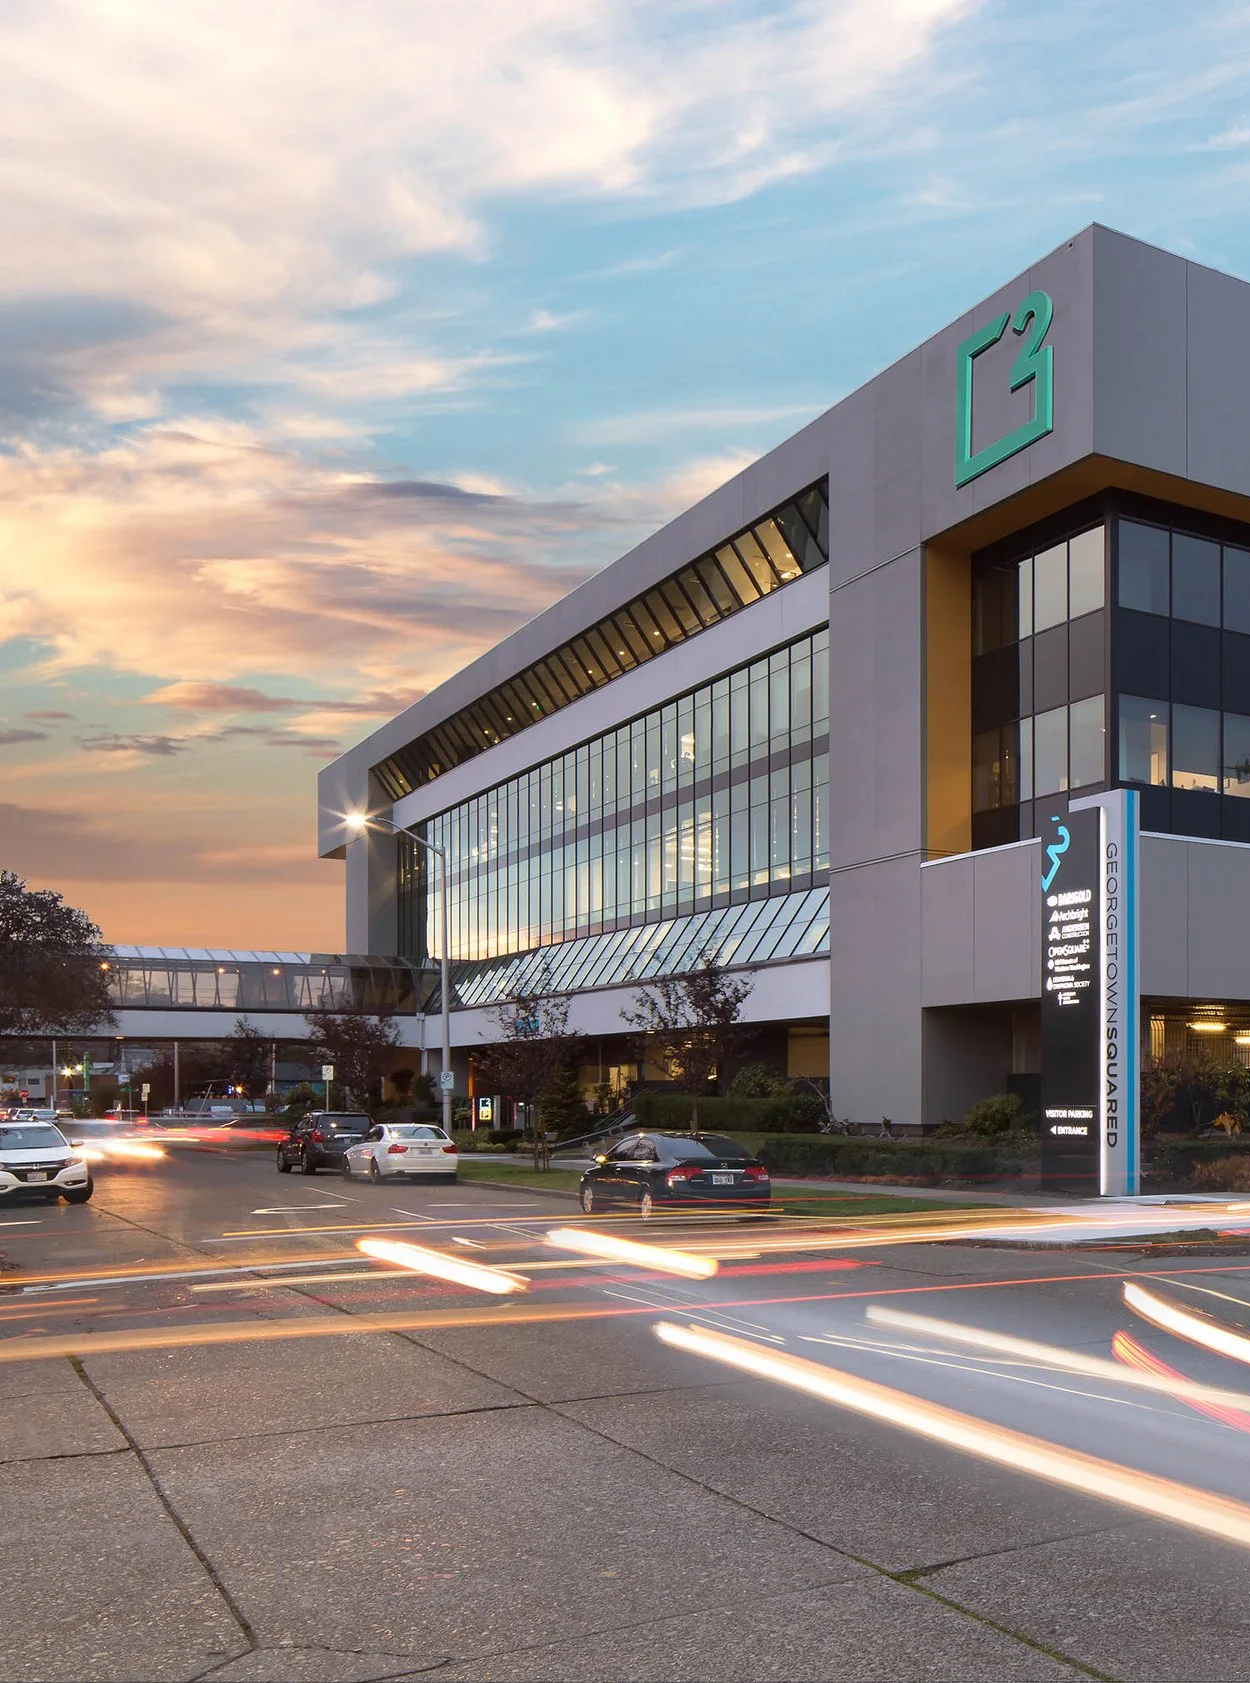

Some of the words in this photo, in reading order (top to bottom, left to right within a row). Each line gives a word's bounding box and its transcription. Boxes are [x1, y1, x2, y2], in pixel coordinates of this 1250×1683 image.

[1106, 842, 1118, 1148] GEORGETOWNSQUARED
[1045, 1109, 1067, 1118] VISITOR
[1068, 1109, 1093, 1119] PARKING
[1057, 1126, 1088, 1135] ENTRANCE
